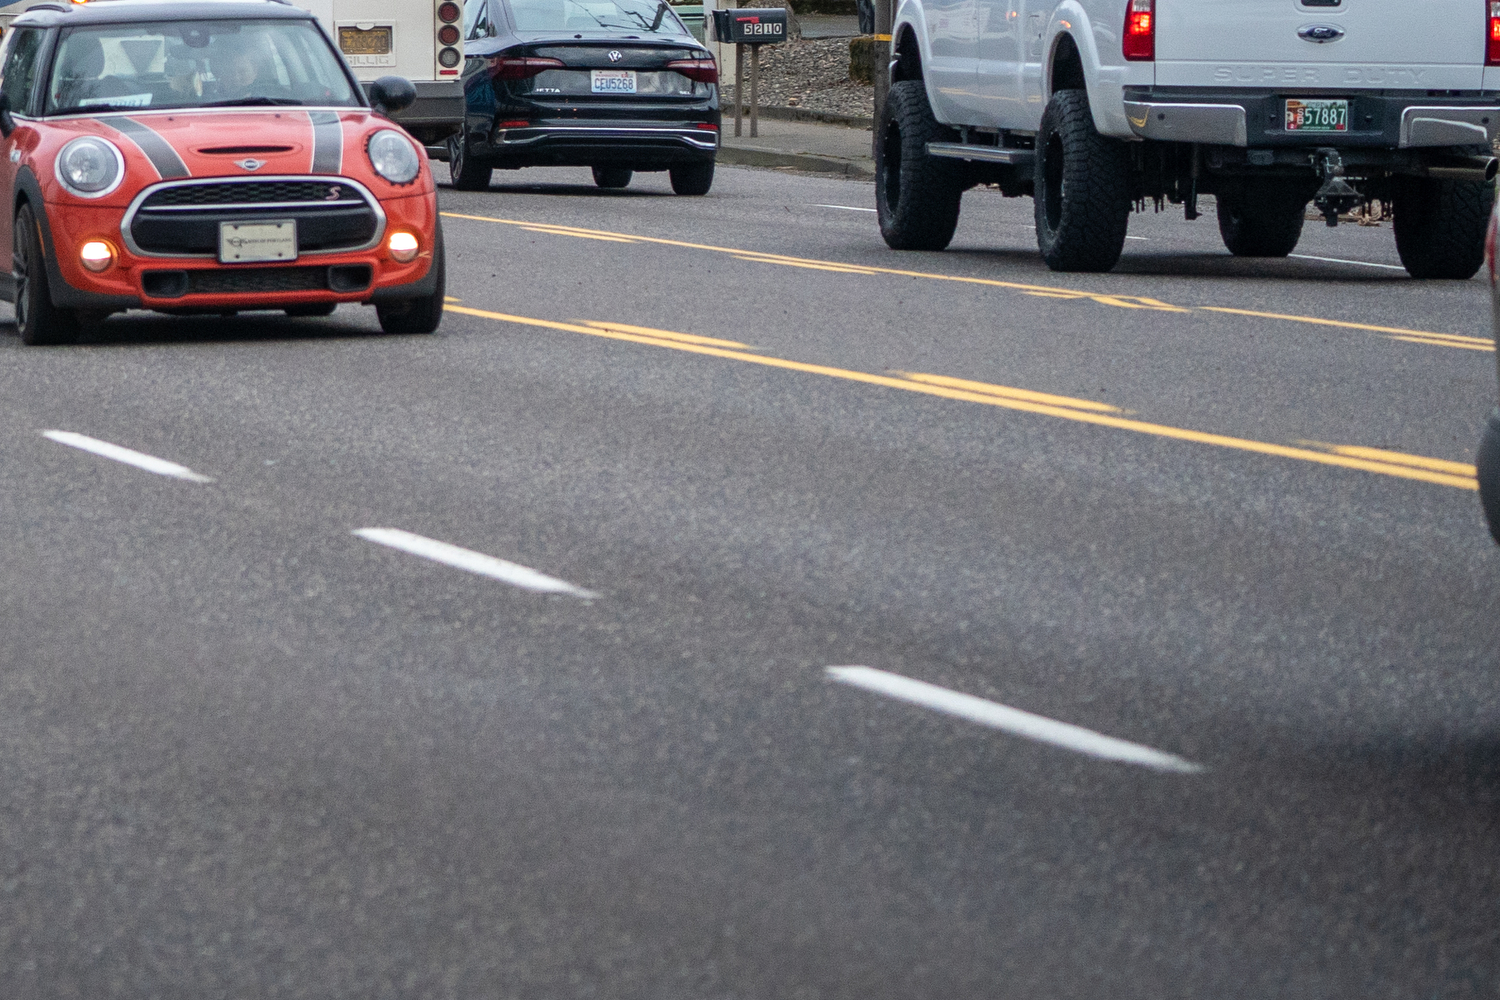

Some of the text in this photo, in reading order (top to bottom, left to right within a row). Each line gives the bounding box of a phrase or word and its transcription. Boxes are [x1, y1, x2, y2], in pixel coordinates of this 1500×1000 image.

[745, 24, 781, 34] 5210
[1214, 67, 1426, 84] SUPER DUTY
[595, 78, 634, 90] CEU5268
[1305, 108, 1345, 125] 57887
[325, 186, 341, 200] S
